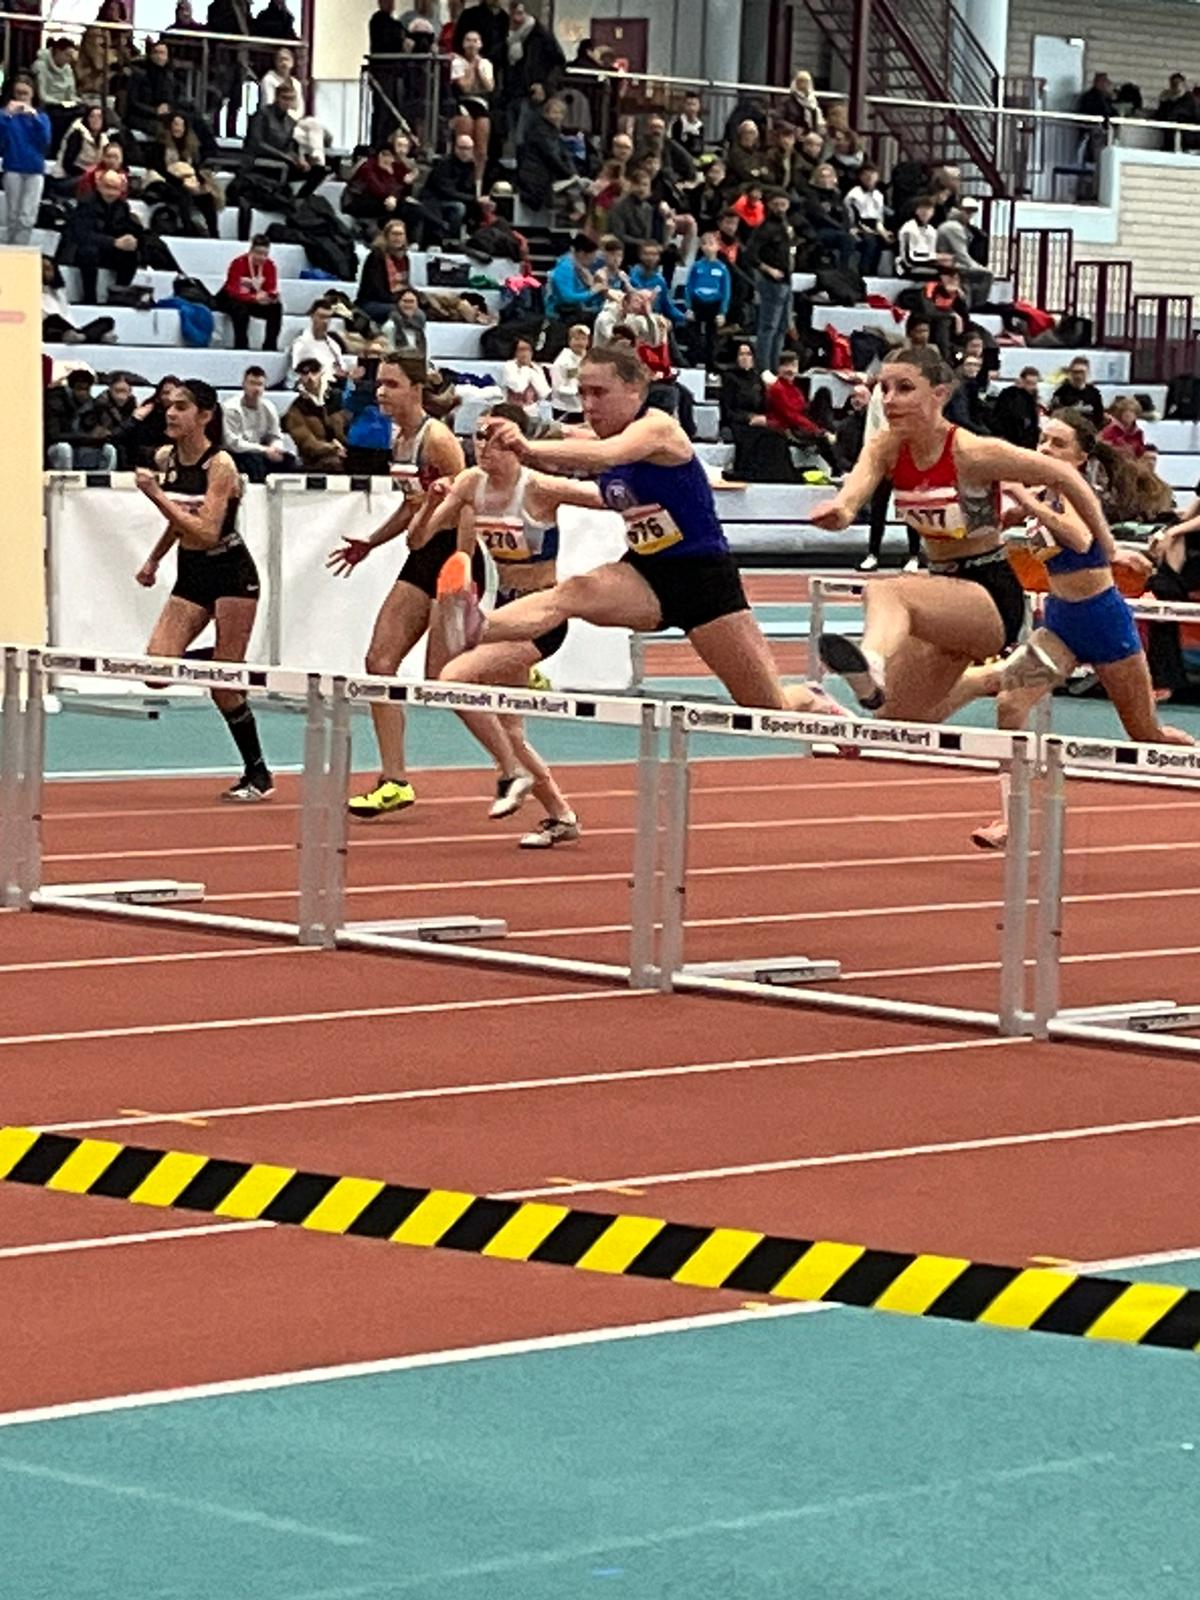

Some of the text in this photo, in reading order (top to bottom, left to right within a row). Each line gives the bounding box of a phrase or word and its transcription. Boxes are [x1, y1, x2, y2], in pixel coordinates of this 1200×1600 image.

[102, 657, 243, 682] Sportstadt Frankfurt
[414, 686, 569, 713] Sportstadt Frankfurt
[760, 715, 931, 746] Sportstadt Frankfurt
